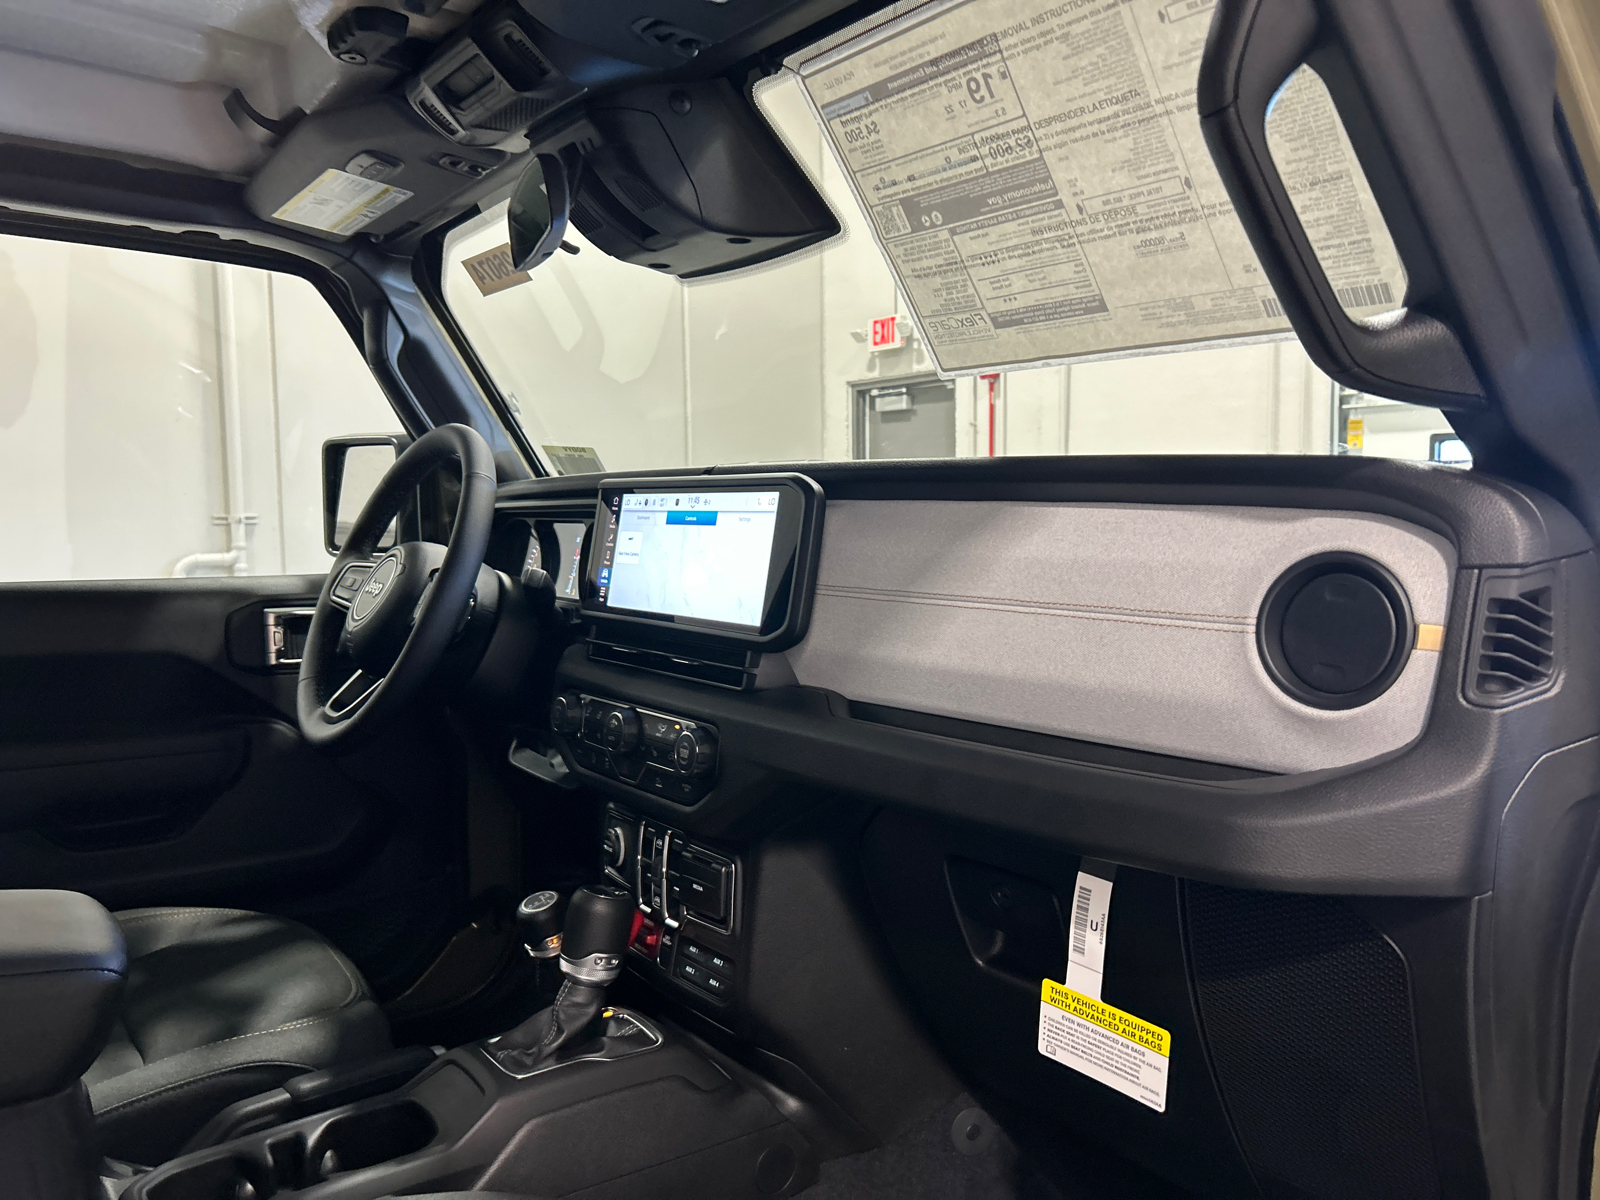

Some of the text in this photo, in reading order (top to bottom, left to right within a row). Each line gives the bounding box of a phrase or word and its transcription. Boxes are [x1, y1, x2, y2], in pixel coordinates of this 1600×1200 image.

[988, 20, 1030, 44] REMOVAL
[1031, 0, 1096, 30] INSTRUCTION
[1003, 40, 1020, 52] other
[1018, 34, 1037, 46] sharp
[1035, 25, 1056, 40] object.
[1056, 22, 1065, 30] To
[1064, 13, 1088, 28] remove
[1042, 37, 1054, 46] and
[1033, 106, 1086, 130] DESPRENDER
[1087, 101, 1098, 115] LA
[1099, 89, 1142, 111] ETIQUETA
[1153, 92, 1180, 105] NUNCA
[1067, 133, 1091, 145] residuo
[1105, 121, 1132, 134] etiqueta
[1136, 108, 1176, 125] pegamento,
[1200, 201, 1218, 210] Pour
[1029, 204, 1139, 237] INSTRUCTIONS DE DÉPOSE
[873, 317, 896, 346] EXIT
[365, 577, 383, 596] Jeep
[1090, 920, 1098, 932] U
[1048, 1016, 1065, 1028] CHILDREN
[1050, 986, 1163, 1041] THIS VEHICLE IS EQUIPPED
[1050, 995, 1162, 1052] WITH ADVANCED AIR BAGS
[1047, 1028, 1060, 1036] NEVER
[1047, 1034, 1062, 1044] ALWAYS
[1062, 1014, 1146, 1058] EVEN WITH ADVANCED AIR BAGS
[1088, 1041, 1102, 1049] SAFEST
